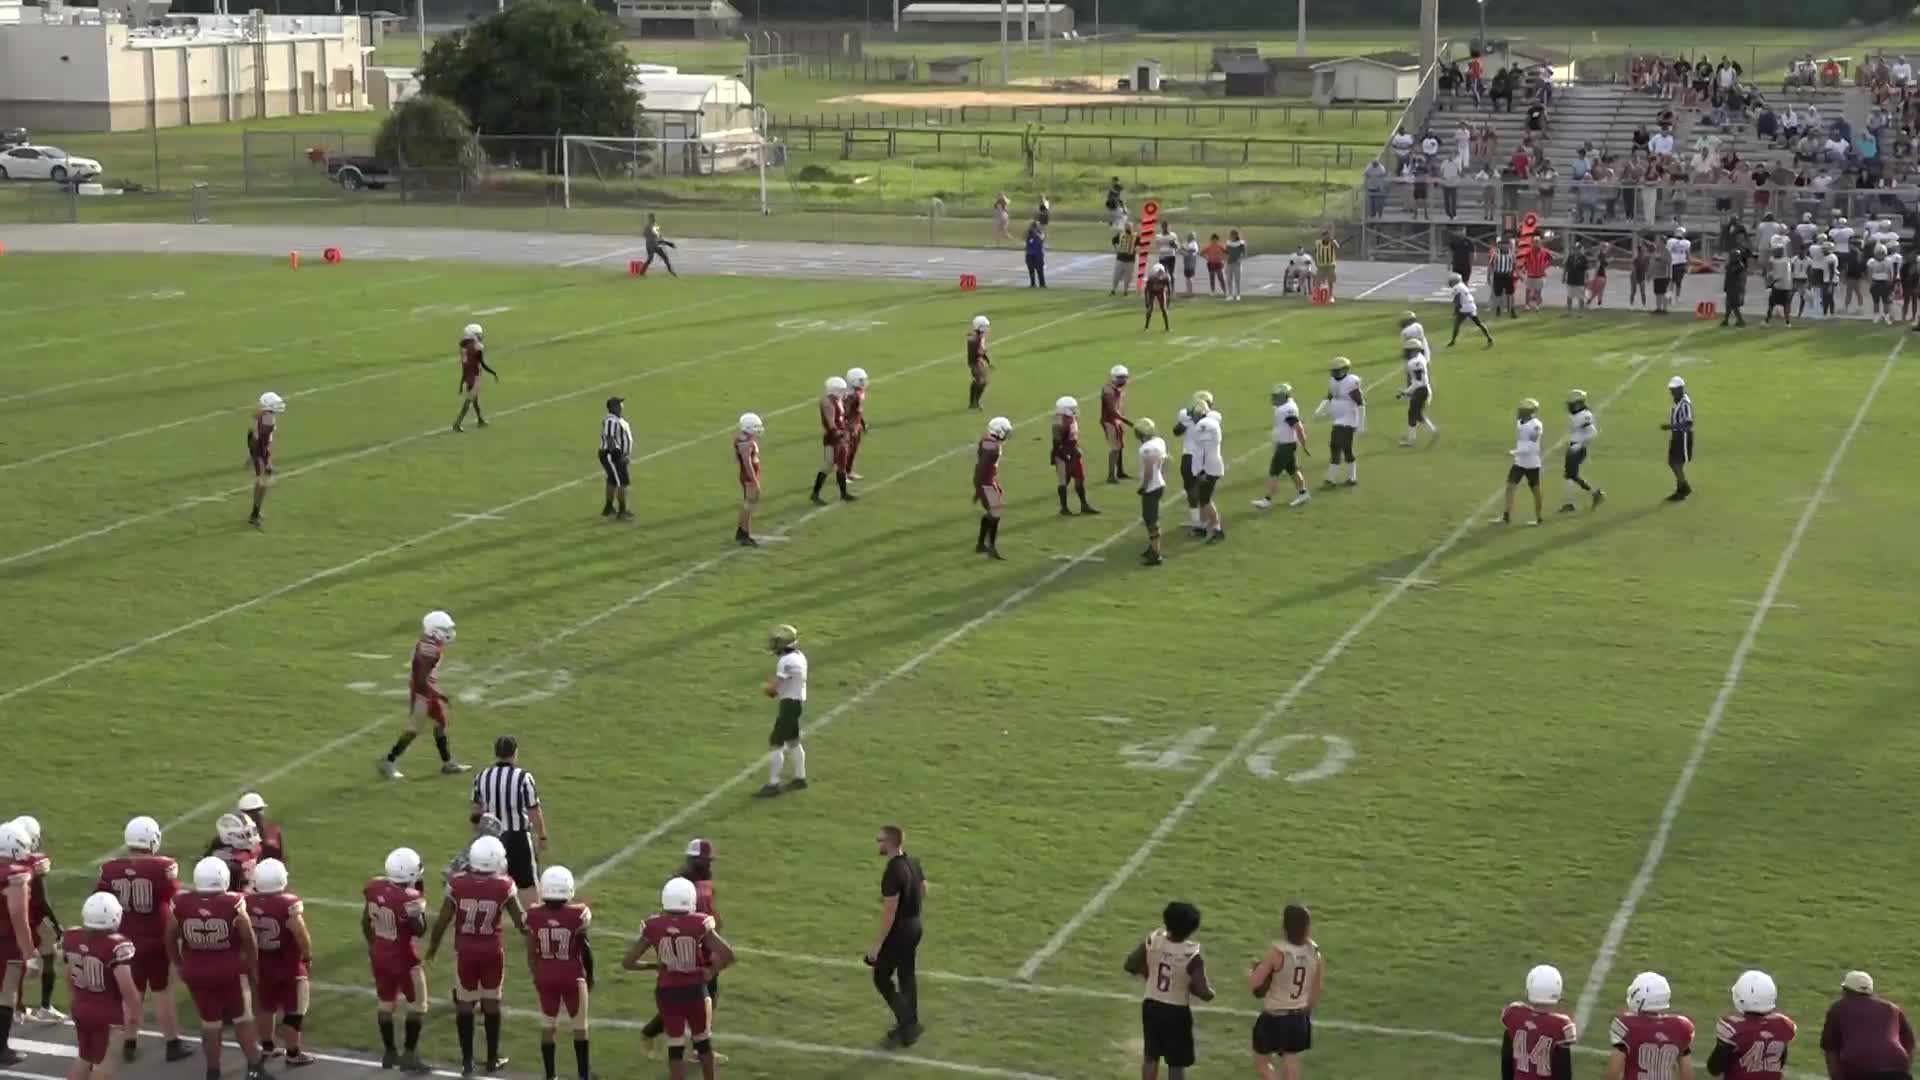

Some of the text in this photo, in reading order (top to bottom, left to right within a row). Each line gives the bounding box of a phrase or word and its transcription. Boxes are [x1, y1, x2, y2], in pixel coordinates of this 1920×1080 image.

[458, 898, 498, 935] 77
[182, 918, 229, 950] 62
[536, 927, 570, 961] 17
[657, 936, 696, 974] 40
[1157, 961, 1171, 992] 6
[1290, 966, 1306, 1000] 9
[1511, 1029, 1552, 1077] 44
[1738, 1040, 1784, 1073] 42
